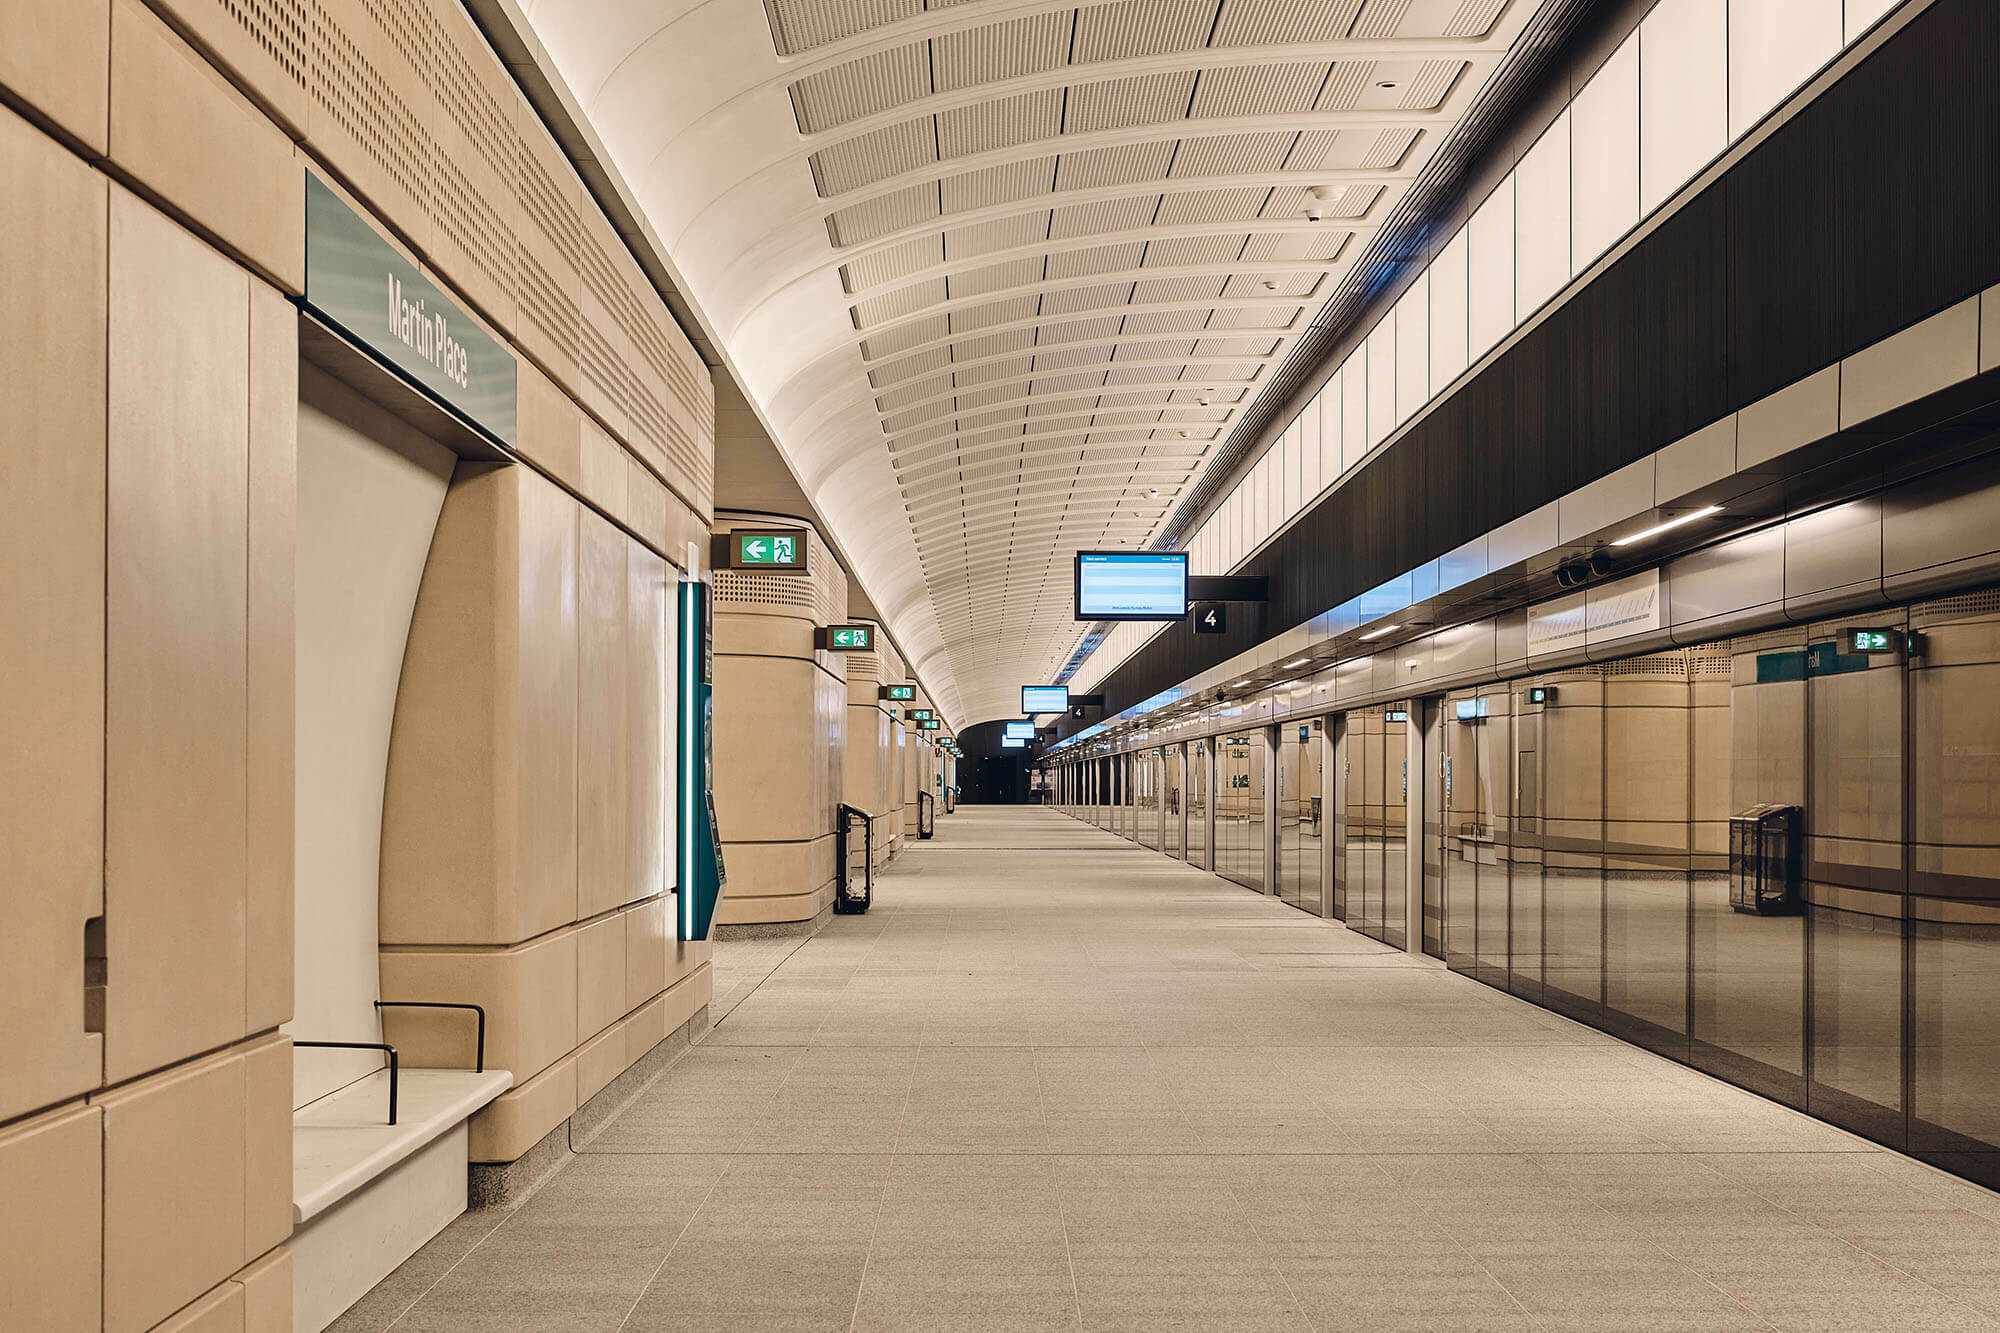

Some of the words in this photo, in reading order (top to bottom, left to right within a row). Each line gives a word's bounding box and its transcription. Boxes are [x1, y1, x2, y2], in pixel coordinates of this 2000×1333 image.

[388, 272, 433, 363] Martin
[435, 312, 468, 389] Place
[1204, 609, 1217, 627] 4
[1075, 708, 1081, 717] 4
